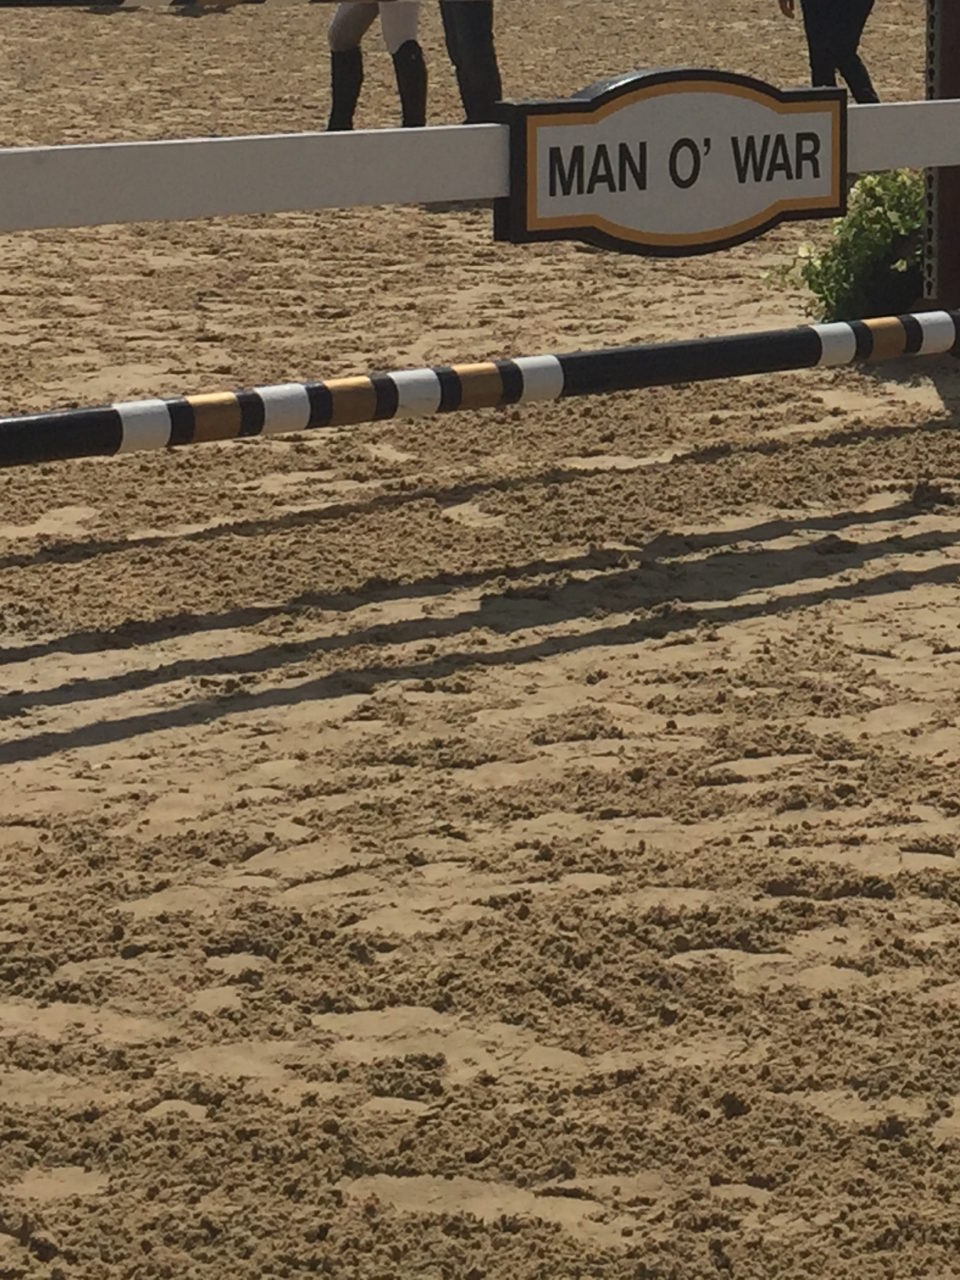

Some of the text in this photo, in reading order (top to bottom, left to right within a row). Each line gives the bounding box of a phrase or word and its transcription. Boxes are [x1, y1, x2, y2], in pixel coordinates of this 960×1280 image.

[549, 131, 821, 197] MAN O' WAR
